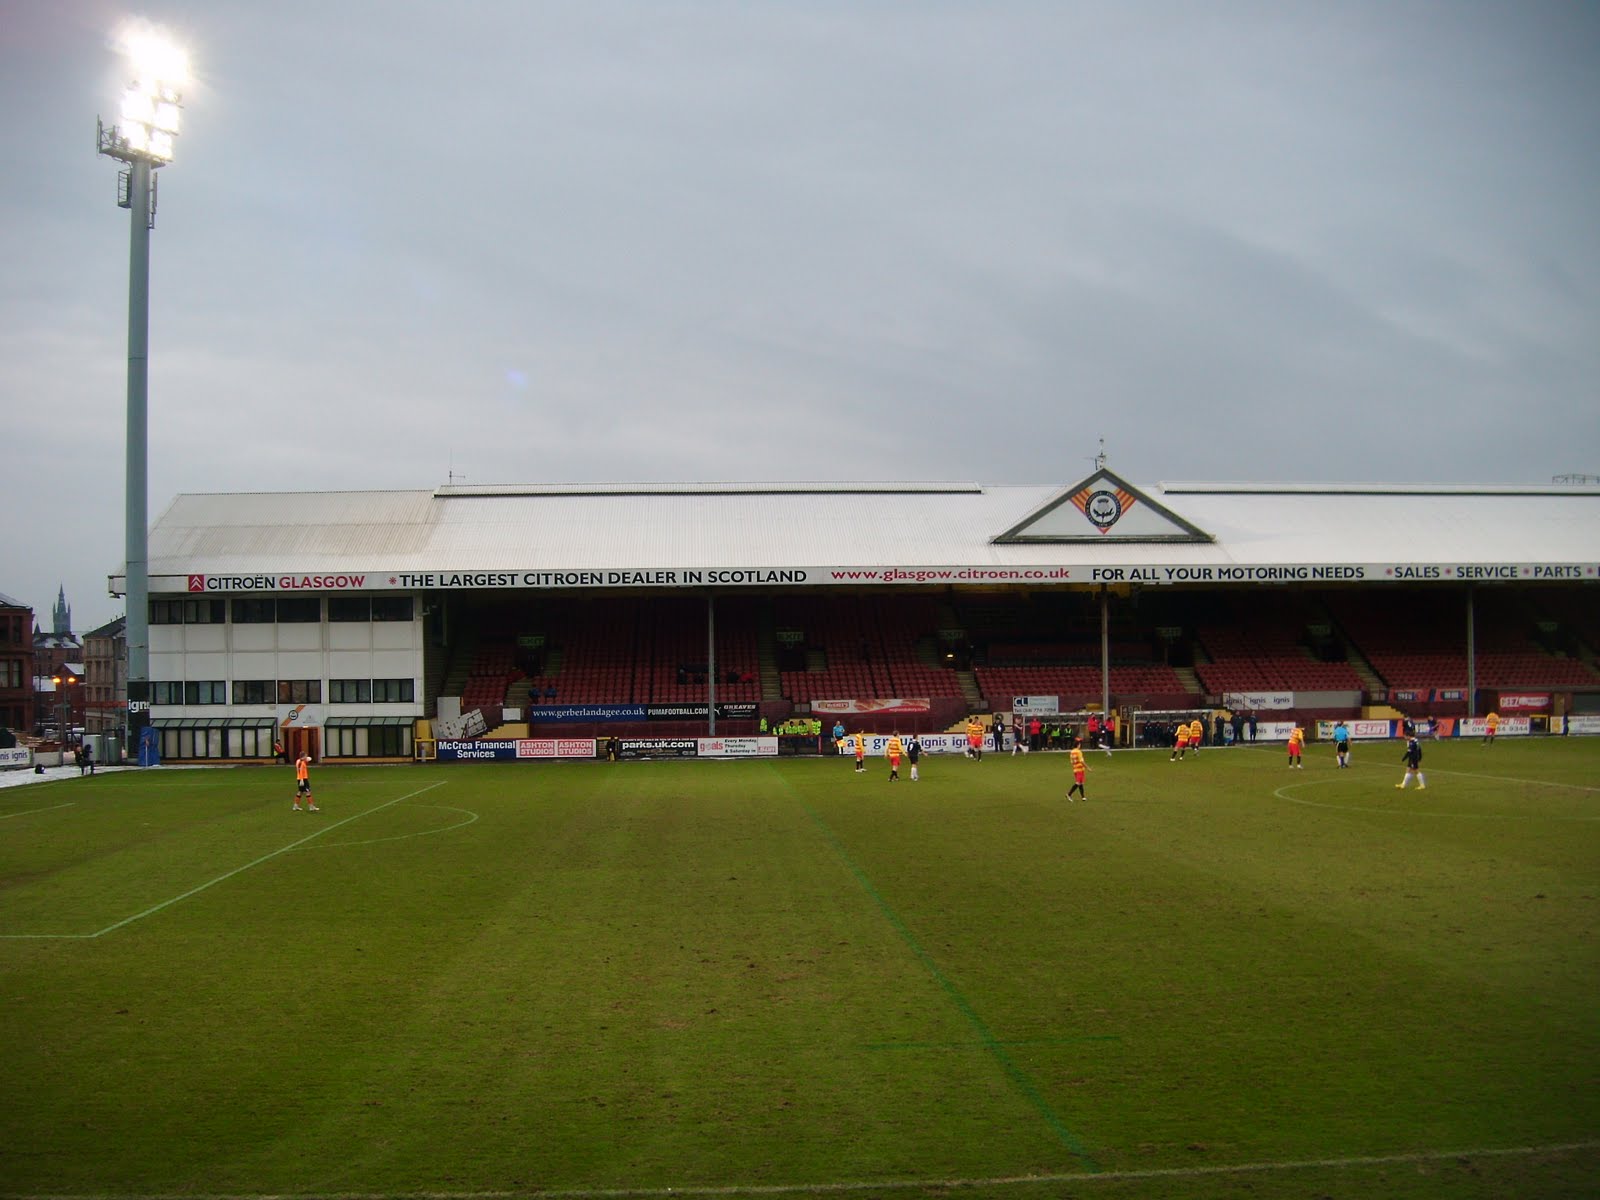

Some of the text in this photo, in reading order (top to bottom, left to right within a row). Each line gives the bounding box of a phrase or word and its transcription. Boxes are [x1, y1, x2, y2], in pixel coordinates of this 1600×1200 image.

[832, 568, 1070, 581] www.glasgow.citroen.co.uk
[1092, 566, 1364, 580] FOR ALL YOUR MOTORING NEEDS
[1394, 566, 1440, 578] SALES
[1456, 566, 1518, 578] SERVICE
[1534, 566, 1582, 577] PARTS
[207, 574, 365, 589] CITROËN GLASGOW
[400, 570, 807, 587] THE LARGEST CITROEN DEALER IN SCOTLAND
[648, 708, 708, 716] PUMAFOOTBALL.COM
[1356, 724, 1386, 734] Sun
[438, 740, 516, 750] McCrea Financial
[622, 741, 694, 750] parks.uk.com
[921, 737, 947, 748] ignis
[952, 737, 970, 748] ign
[12, 750, 28, 762] ignis
[457, 750, 495, 758] Services
